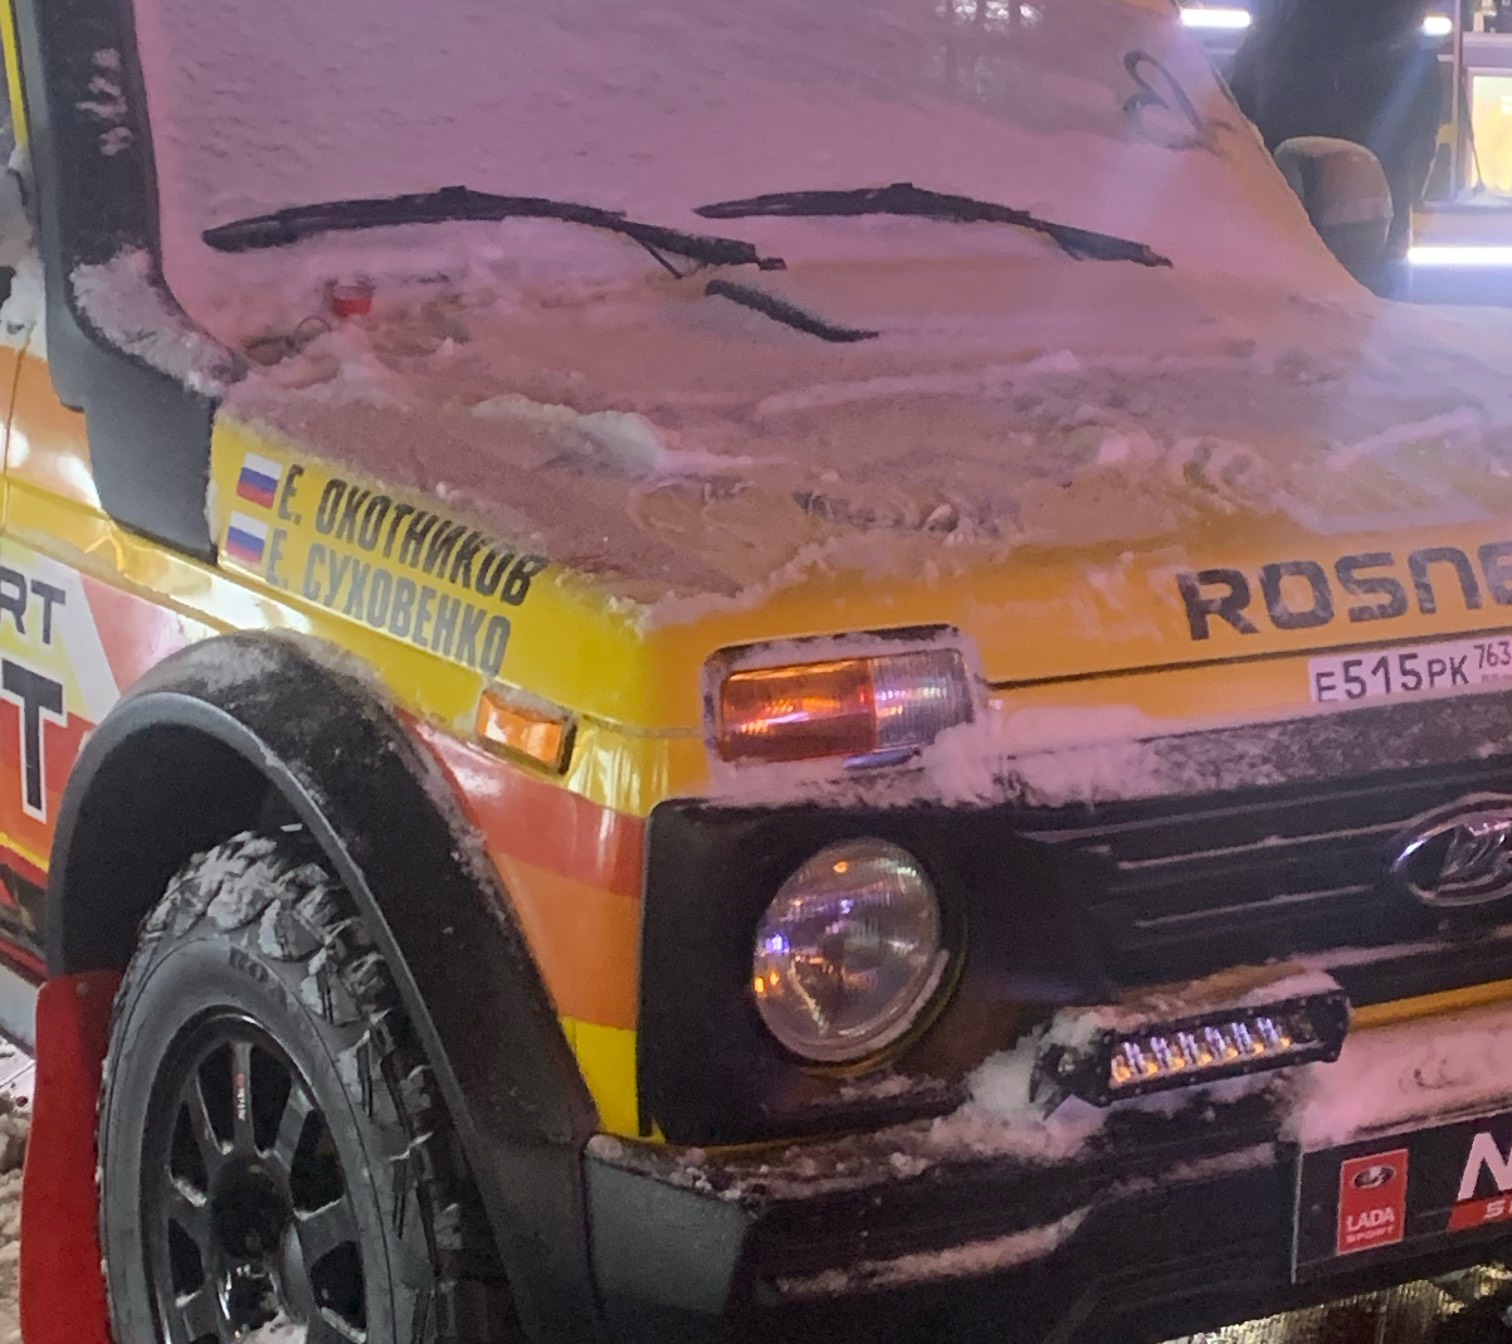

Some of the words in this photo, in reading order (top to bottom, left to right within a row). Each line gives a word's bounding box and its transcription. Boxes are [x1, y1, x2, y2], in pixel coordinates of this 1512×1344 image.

[315, 477, 550, 607] ОХОТНИКОВ
[304, 544, 513, 677] СУХОВЕНКО
[1345, 1206, 1396, 1232] LADA
